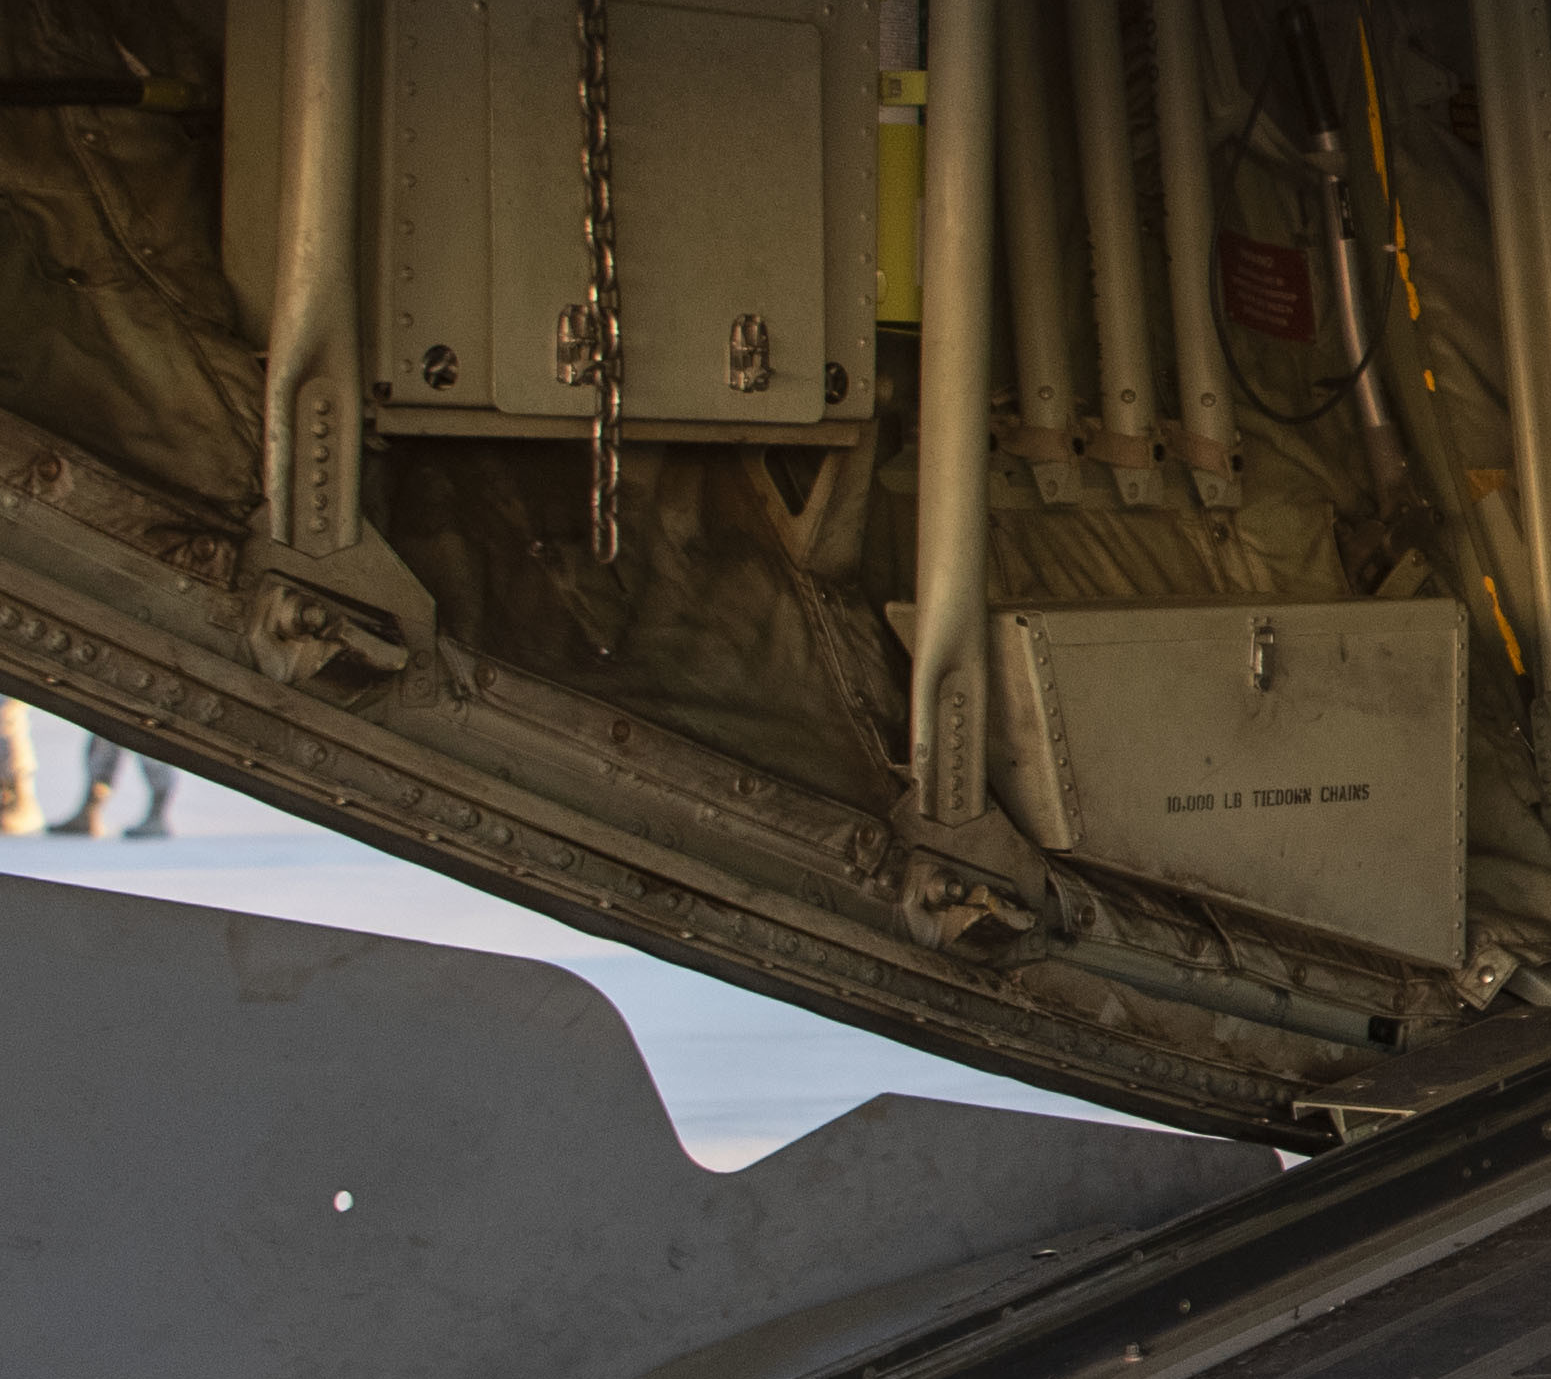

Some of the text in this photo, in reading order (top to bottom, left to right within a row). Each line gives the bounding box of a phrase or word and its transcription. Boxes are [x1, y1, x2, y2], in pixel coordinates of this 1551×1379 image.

[1223, 792, 1242, 810] LB
[1252, 788, 1312, 807] TIEDOWN
[1320, 784, 1370, 803] CHAINS
